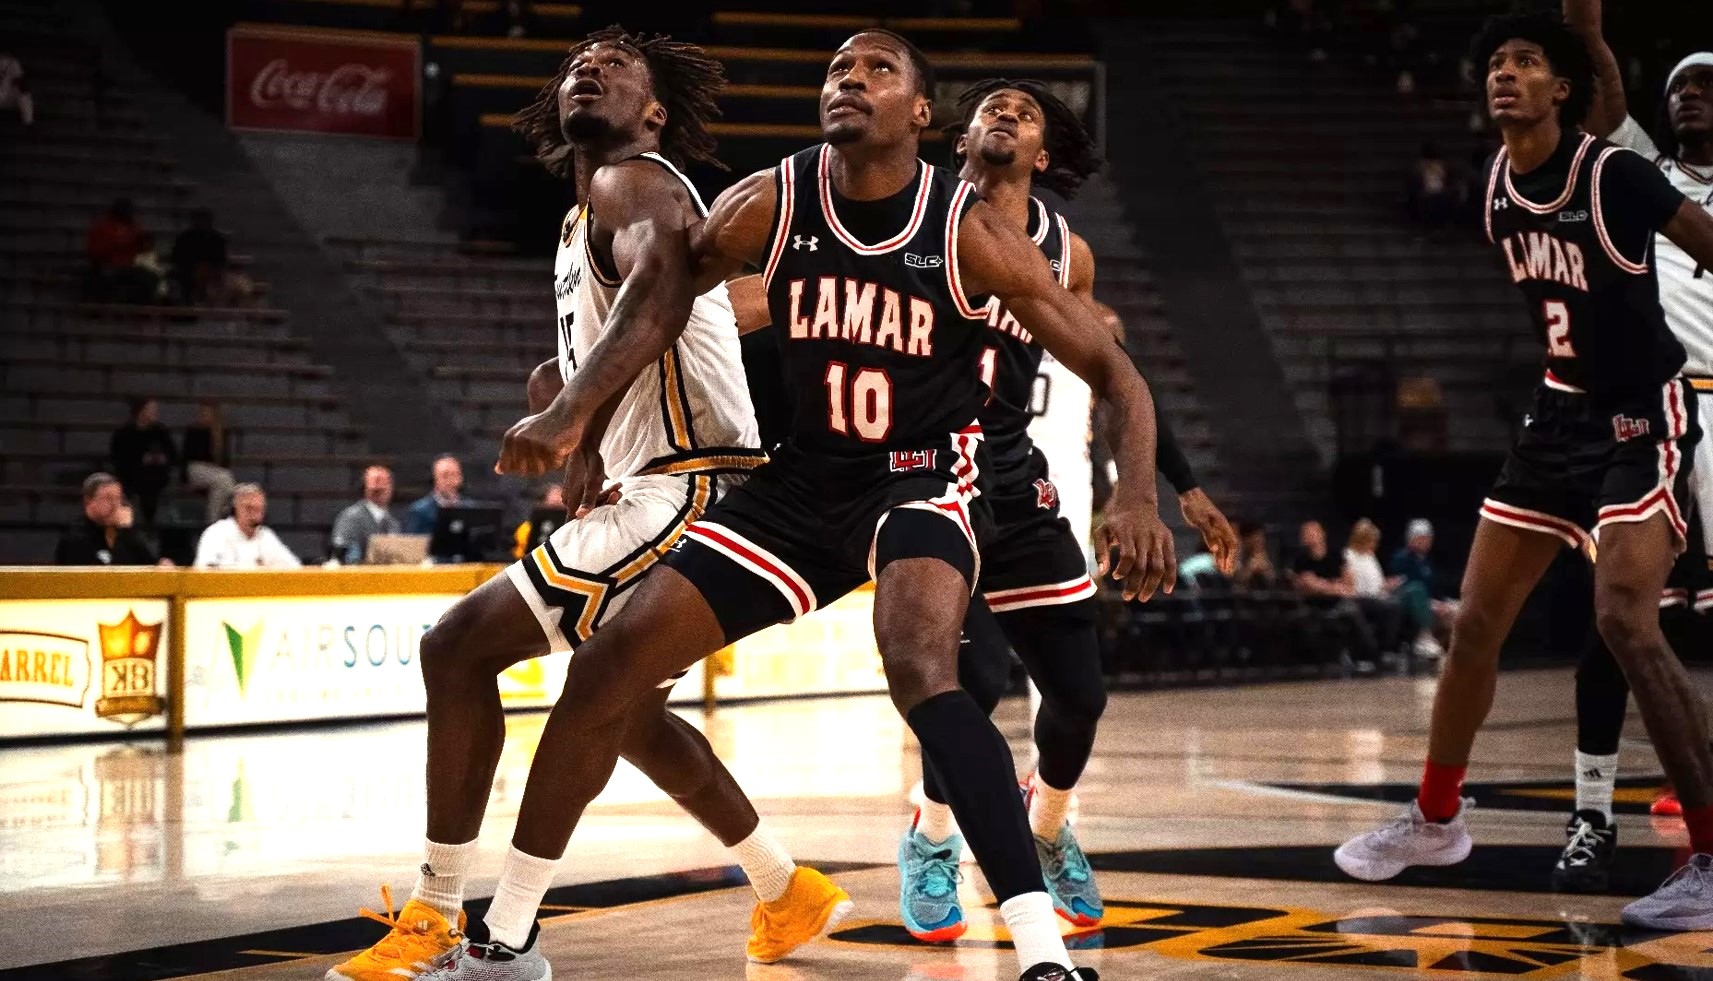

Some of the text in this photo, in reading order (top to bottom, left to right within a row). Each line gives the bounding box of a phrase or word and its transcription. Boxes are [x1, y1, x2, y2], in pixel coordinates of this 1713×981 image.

[788, 275, 935, 357] LAMAR
[824, 360, 893, 443] 10
[0, 649, 74, 687] ARREL
[267, 623, 432, 673] AIRSOU
